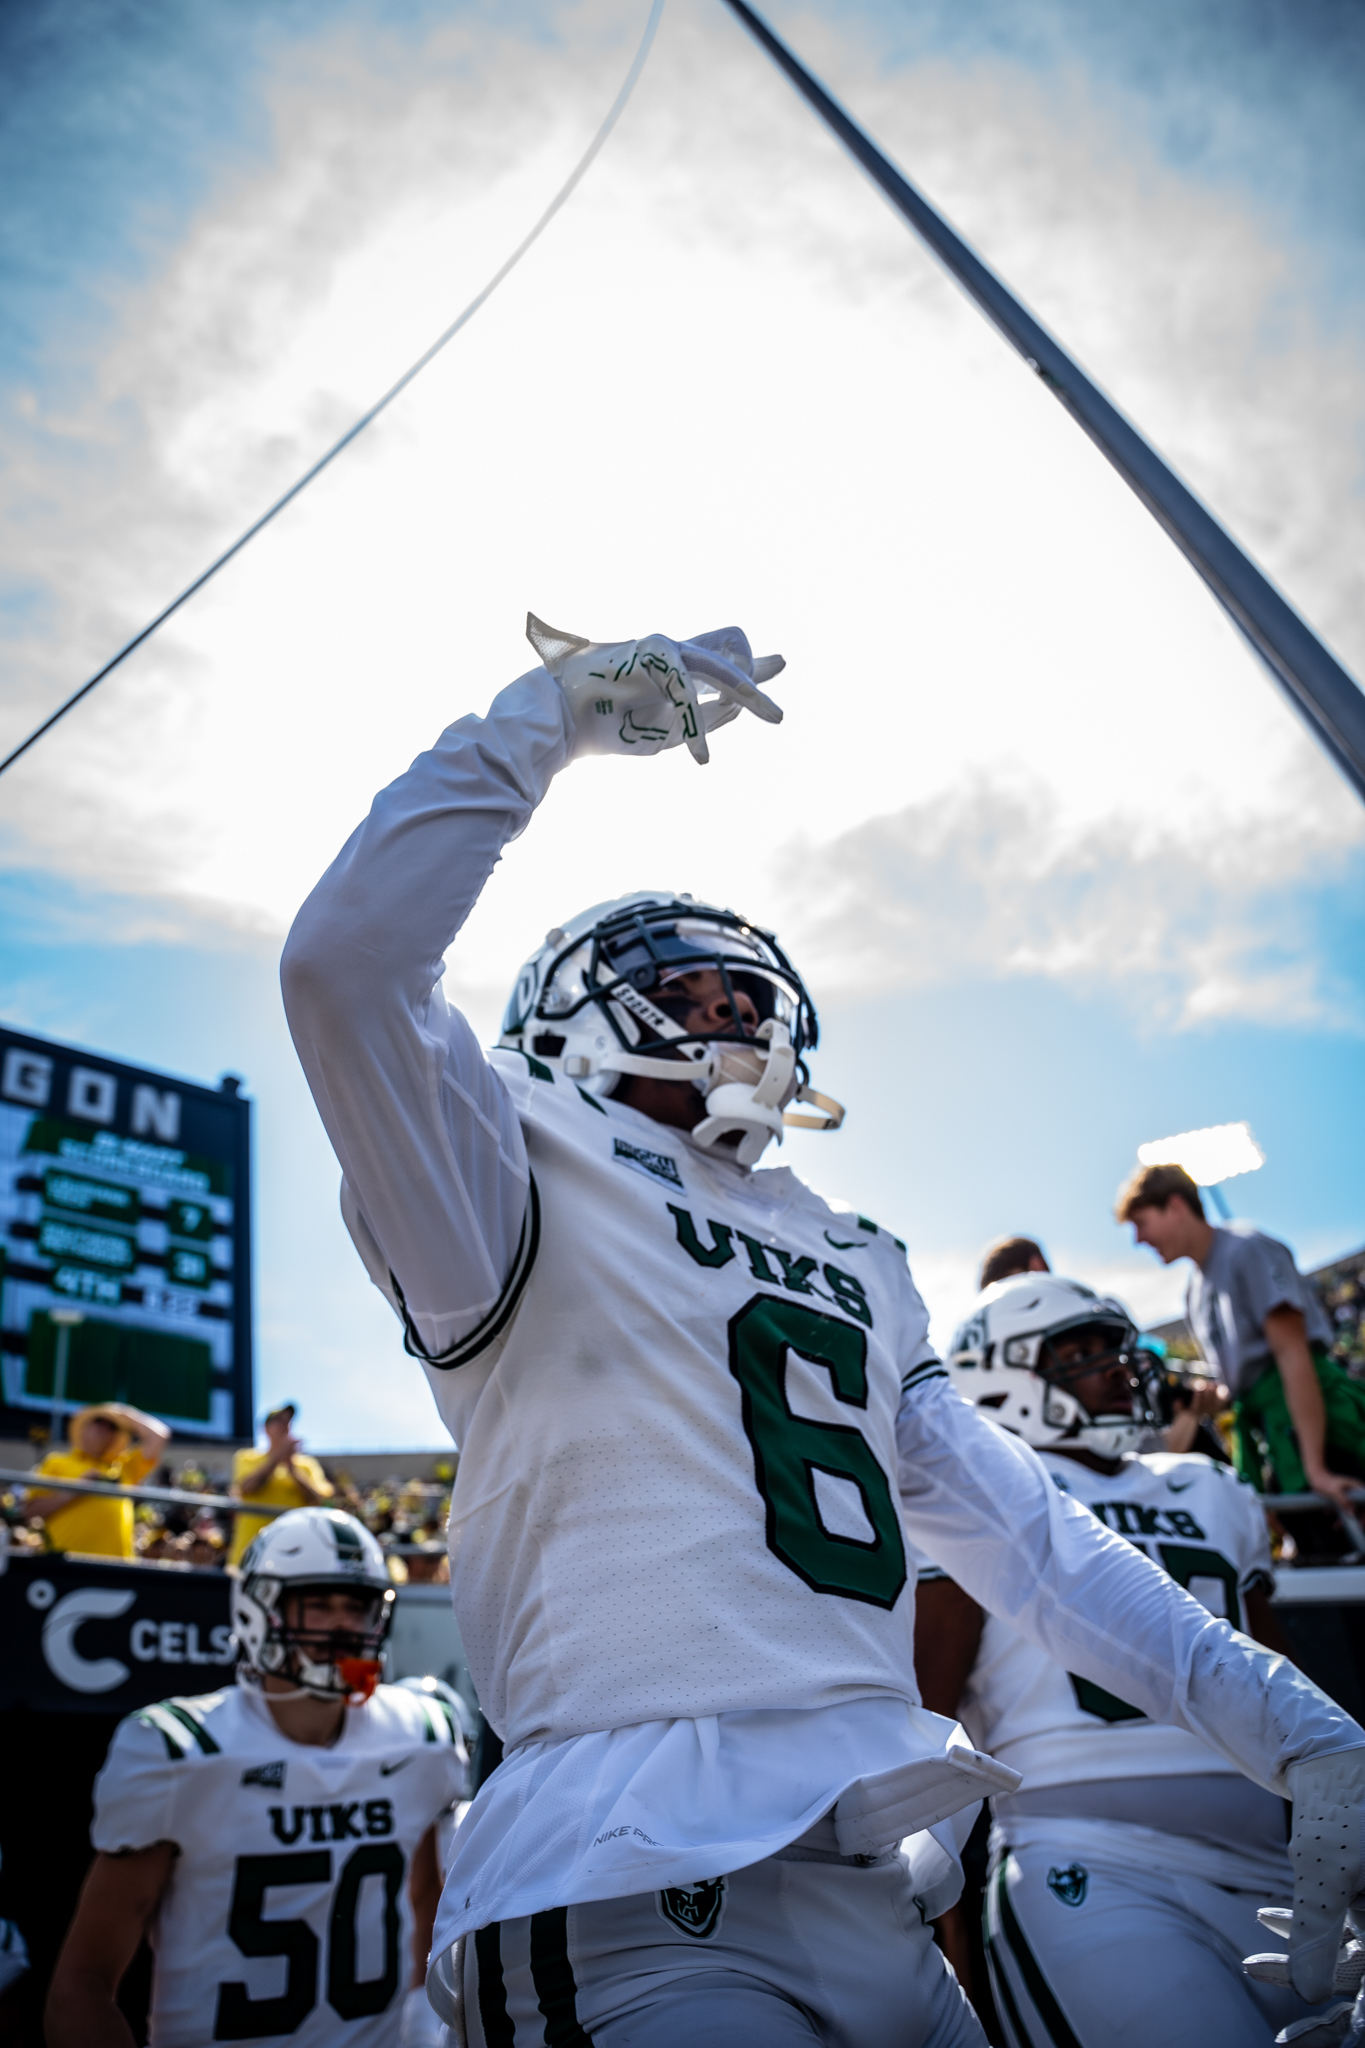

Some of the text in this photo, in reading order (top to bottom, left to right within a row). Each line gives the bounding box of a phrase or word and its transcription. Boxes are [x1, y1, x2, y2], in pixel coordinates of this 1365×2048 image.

[2, 1047, 181, 1143] GON
[666, 1202, 873, 1329] VIKS
[727, 1292, 908, 1611] 6
[130, 1618, 239, 1665] CELS
[268, 1798, 393, 1844] VIKS
[593, 1825, 632, 1847] NIKE
[213, 1841, 406, 2041] 50
